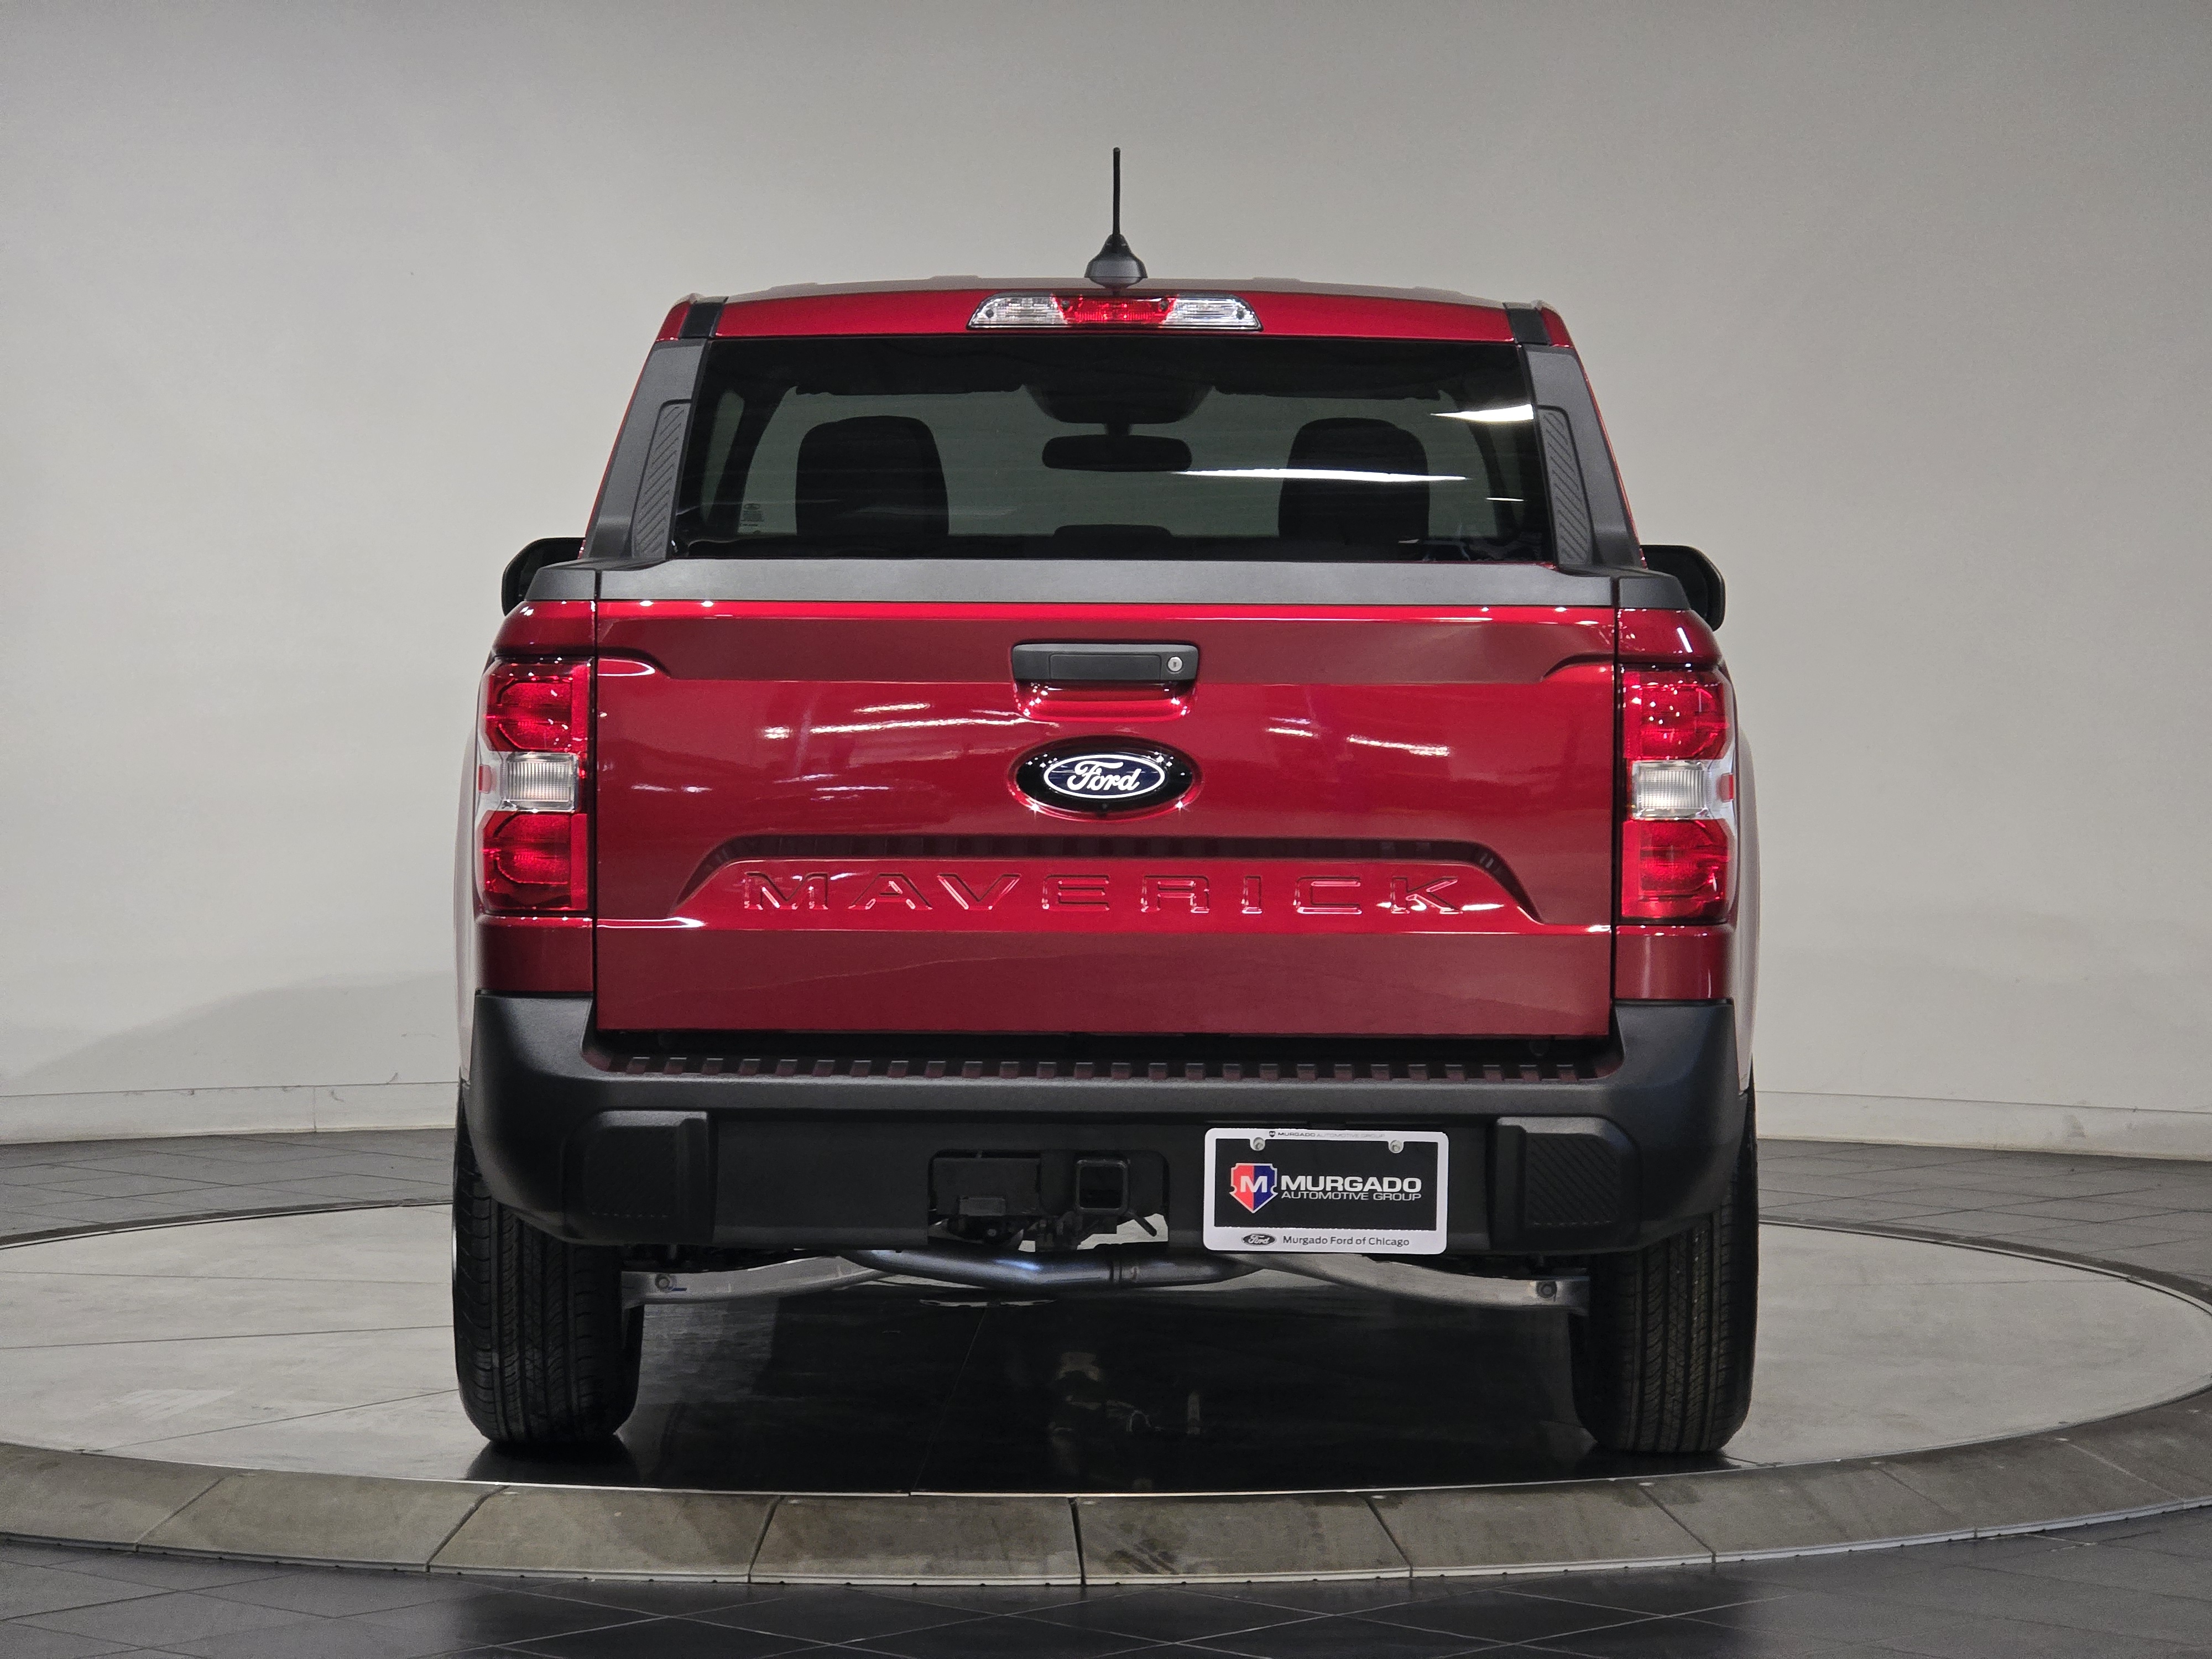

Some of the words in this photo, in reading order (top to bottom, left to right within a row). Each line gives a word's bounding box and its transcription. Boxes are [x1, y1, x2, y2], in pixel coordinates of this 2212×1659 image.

[1067, 760, 1142, 791] Ford
[743, 871, 1463, 915] MAVERICK
[1240, 1175, 1267, 1193] M
[1281, 1175, 1422, 1193] MURGADO
[1281, 1191, 1369, 1200] AUTOMOTIVE
[1373, 1192, 1422, 1201] GROUP
[1248, 1234, 1270, 1244] Ford
[1283, 1235, 1328, 1245] Murgado
[1355, 1237, 1366, 1245] of
[1369, 1237, 1410, 1247] Chicago
